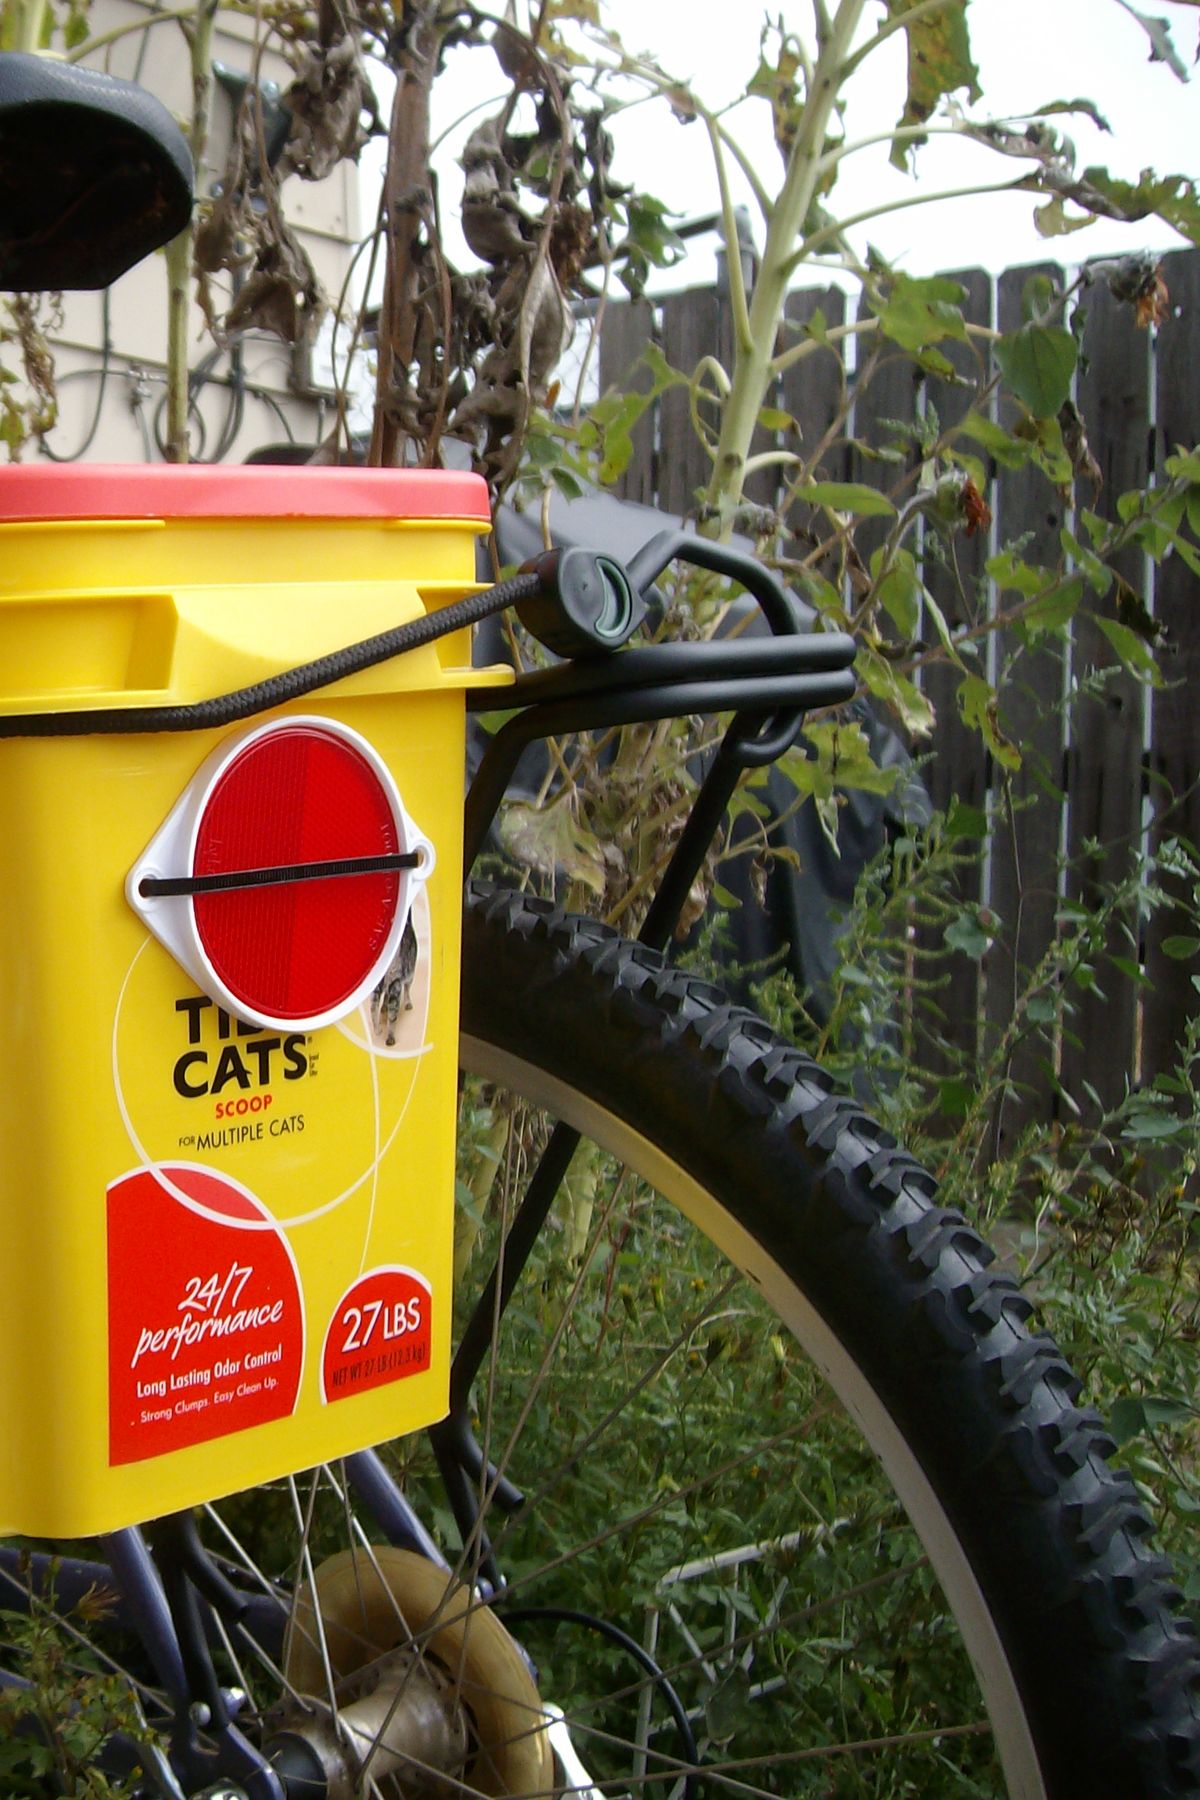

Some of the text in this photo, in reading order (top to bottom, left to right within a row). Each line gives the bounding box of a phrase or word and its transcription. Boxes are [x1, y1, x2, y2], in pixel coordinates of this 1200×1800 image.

[173, 1033, 308, 1099] CATS
[178, 1114, 306, 1152] FOR MULTIPLE CATS
[215, 1094, 274, 1121] SCOOP
[177, 1261, 254, 1318] 24/7
[130, 1299, 284, 1370] performance
[341, 1296, 421, 1354] 27 LBS
[136, 1343, 283, 1399] Long Lasting Odor Control
[140, 1406, 173, 1424] Strong
[213, 1389, 235, 1405] Easy
[236, 1381, 262, 1398] Clean
